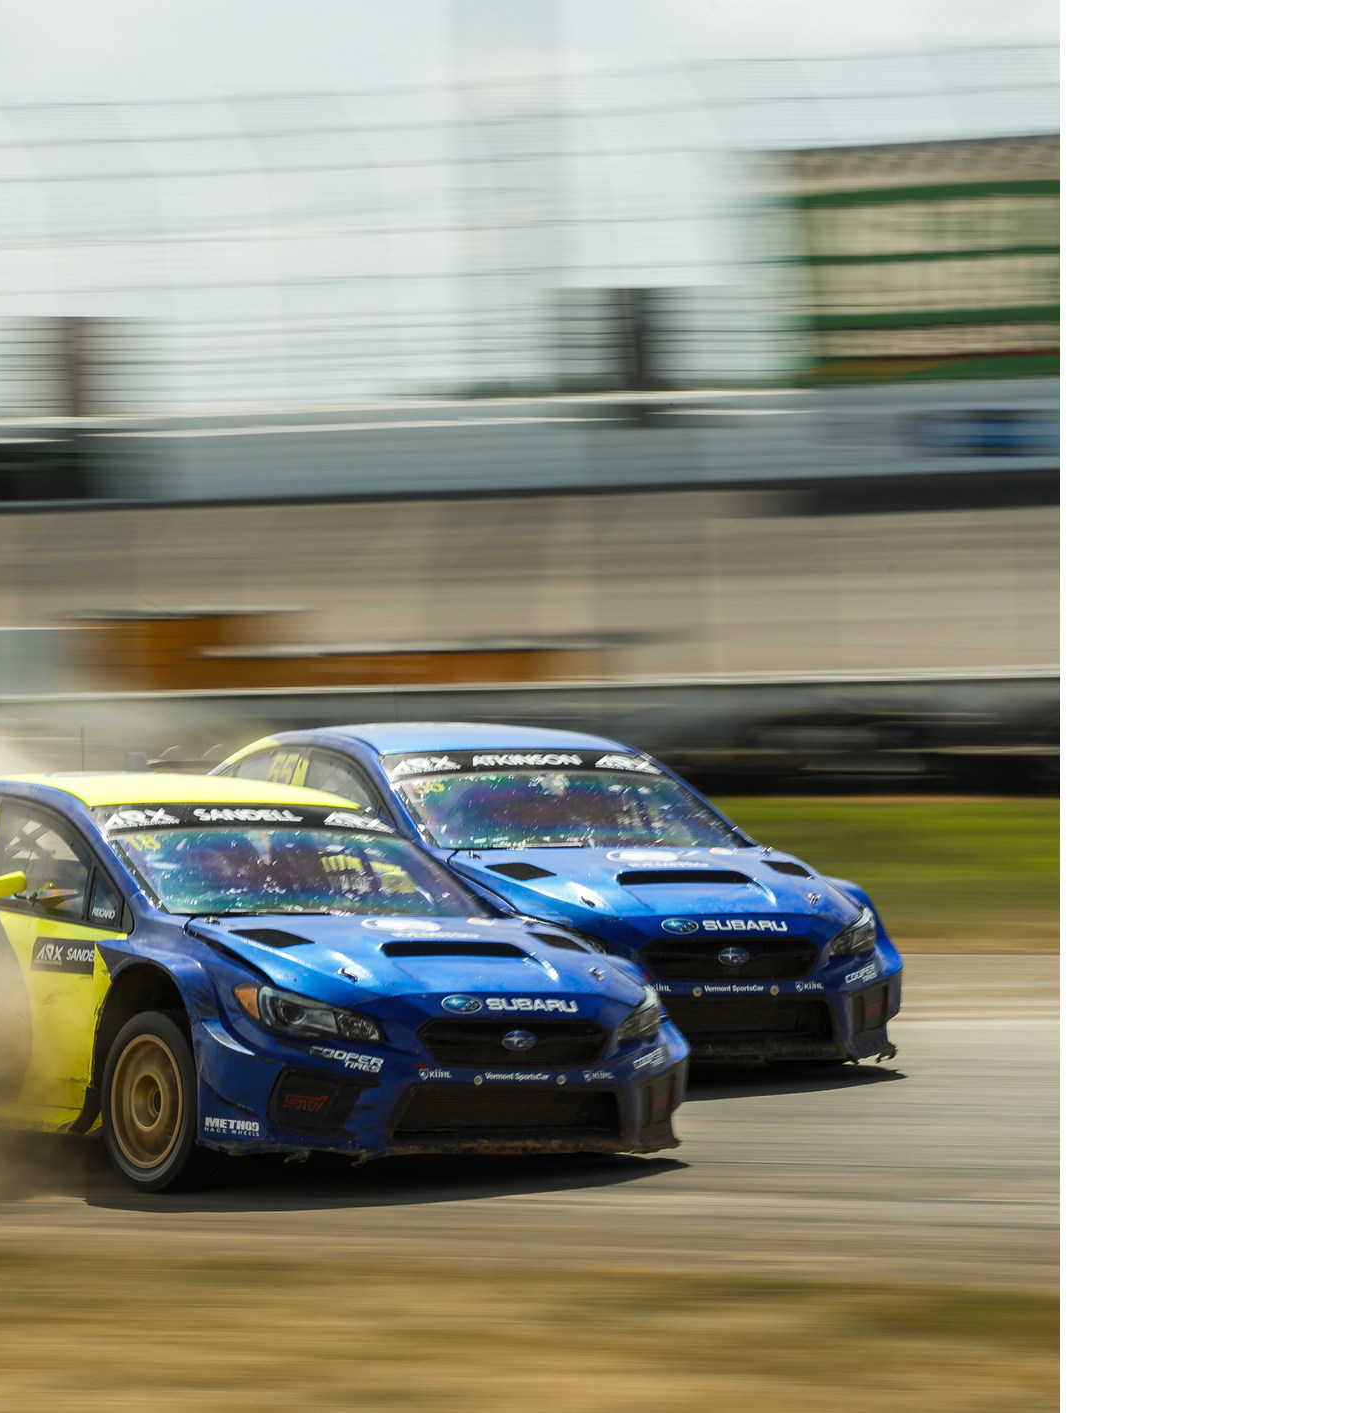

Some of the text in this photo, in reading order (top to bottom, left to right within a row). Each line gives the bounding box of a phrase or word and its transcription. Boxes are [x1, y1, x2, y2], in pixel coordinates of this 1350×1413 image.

[472, 754, 584, 767] ATKINSON
[193, 808, 304, 822] SANDELL
[124, 834, 161, 852] 18
[701, 919, 788, 932] SUBARU
[36, 943, 65, 961] ARX
[732, 985, 764, 993] SportsCar
[486, 998, 579, 1014] SUBARU
[344, 1060, 382, 1073] TIRES
[485, 1072, 550, 1082] Vermont SportsCar
[205, 1116, 260, 1132] METHOD
[204, 1126, 260, 1138] RACE WHEELS
